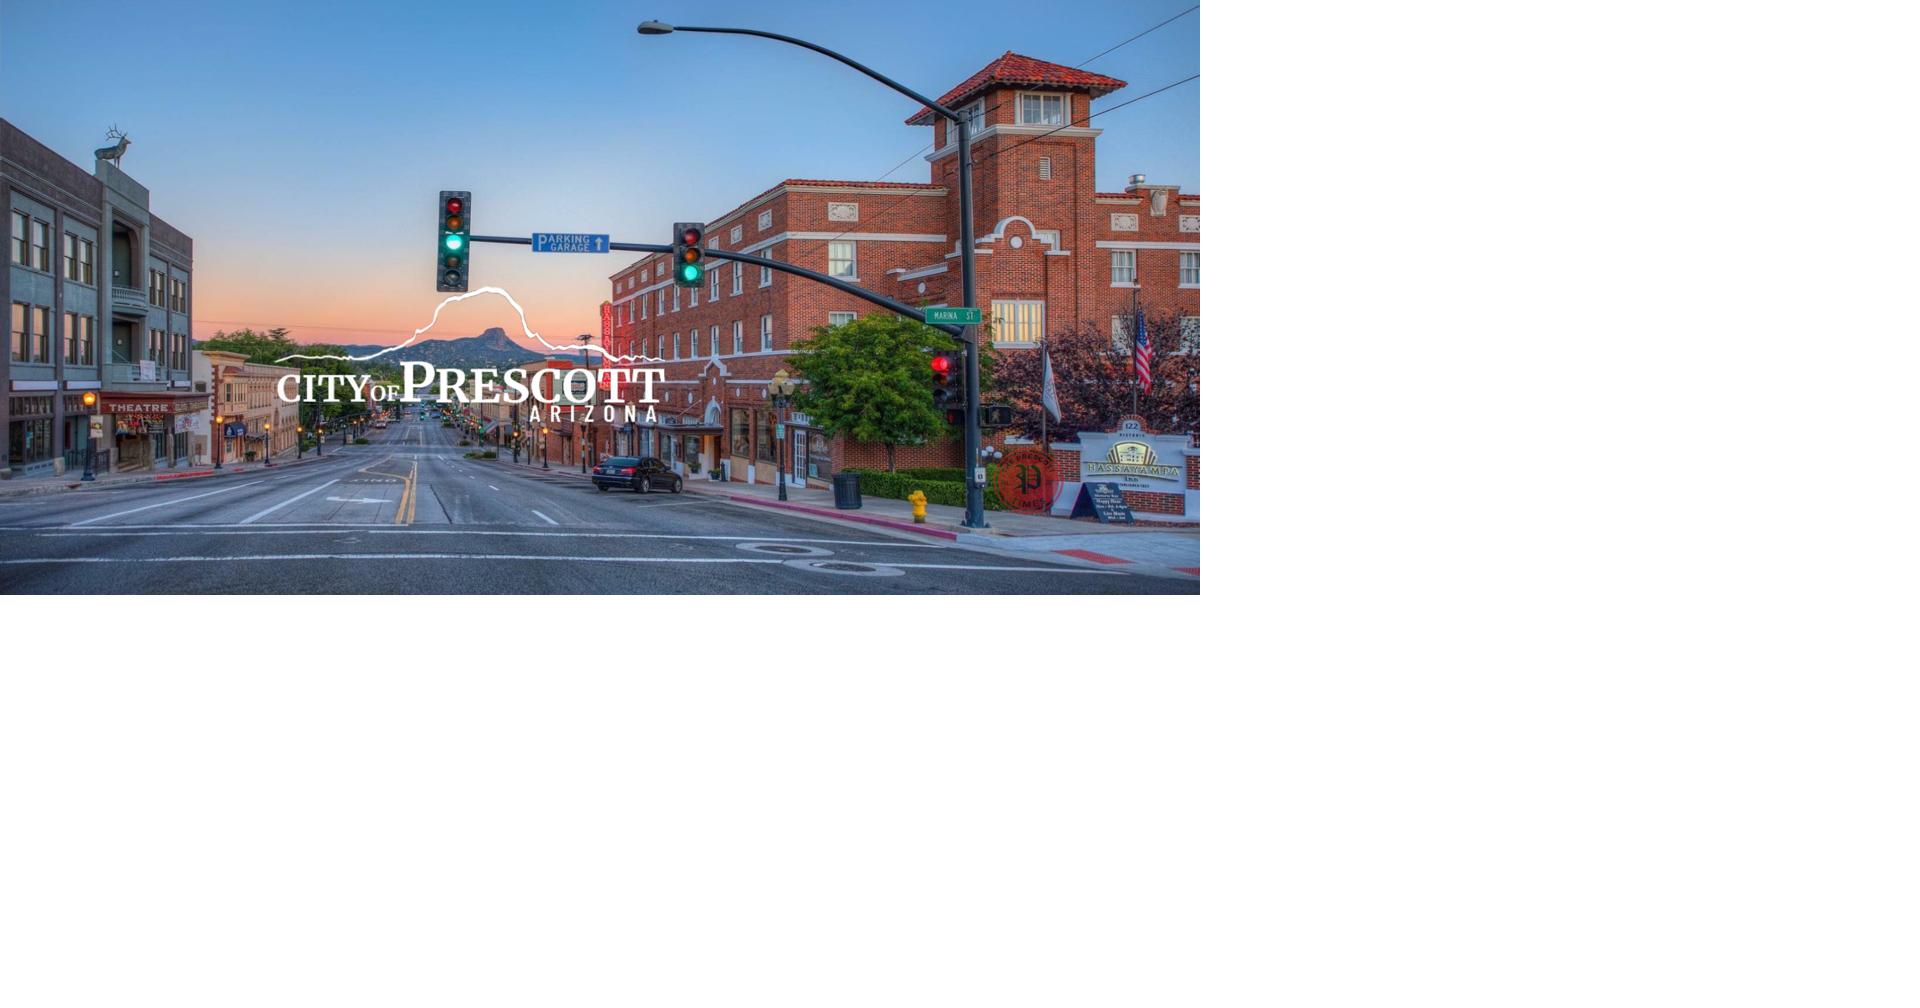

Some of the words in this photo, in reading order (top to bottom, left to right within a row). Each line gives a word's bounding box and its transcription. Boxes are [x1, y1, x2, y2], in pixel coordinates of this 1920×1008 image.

[538, 234, 590, 250] PARKING
[550, 243, 590, 252] GARAGE
[934, 311, 958, 320] MARINA
[602, 305, 612, 381] HASSAYMA
[109, 403, 168, 412] THEATRE
[1088, 463, 1179, 476] HASSAYAMPA
